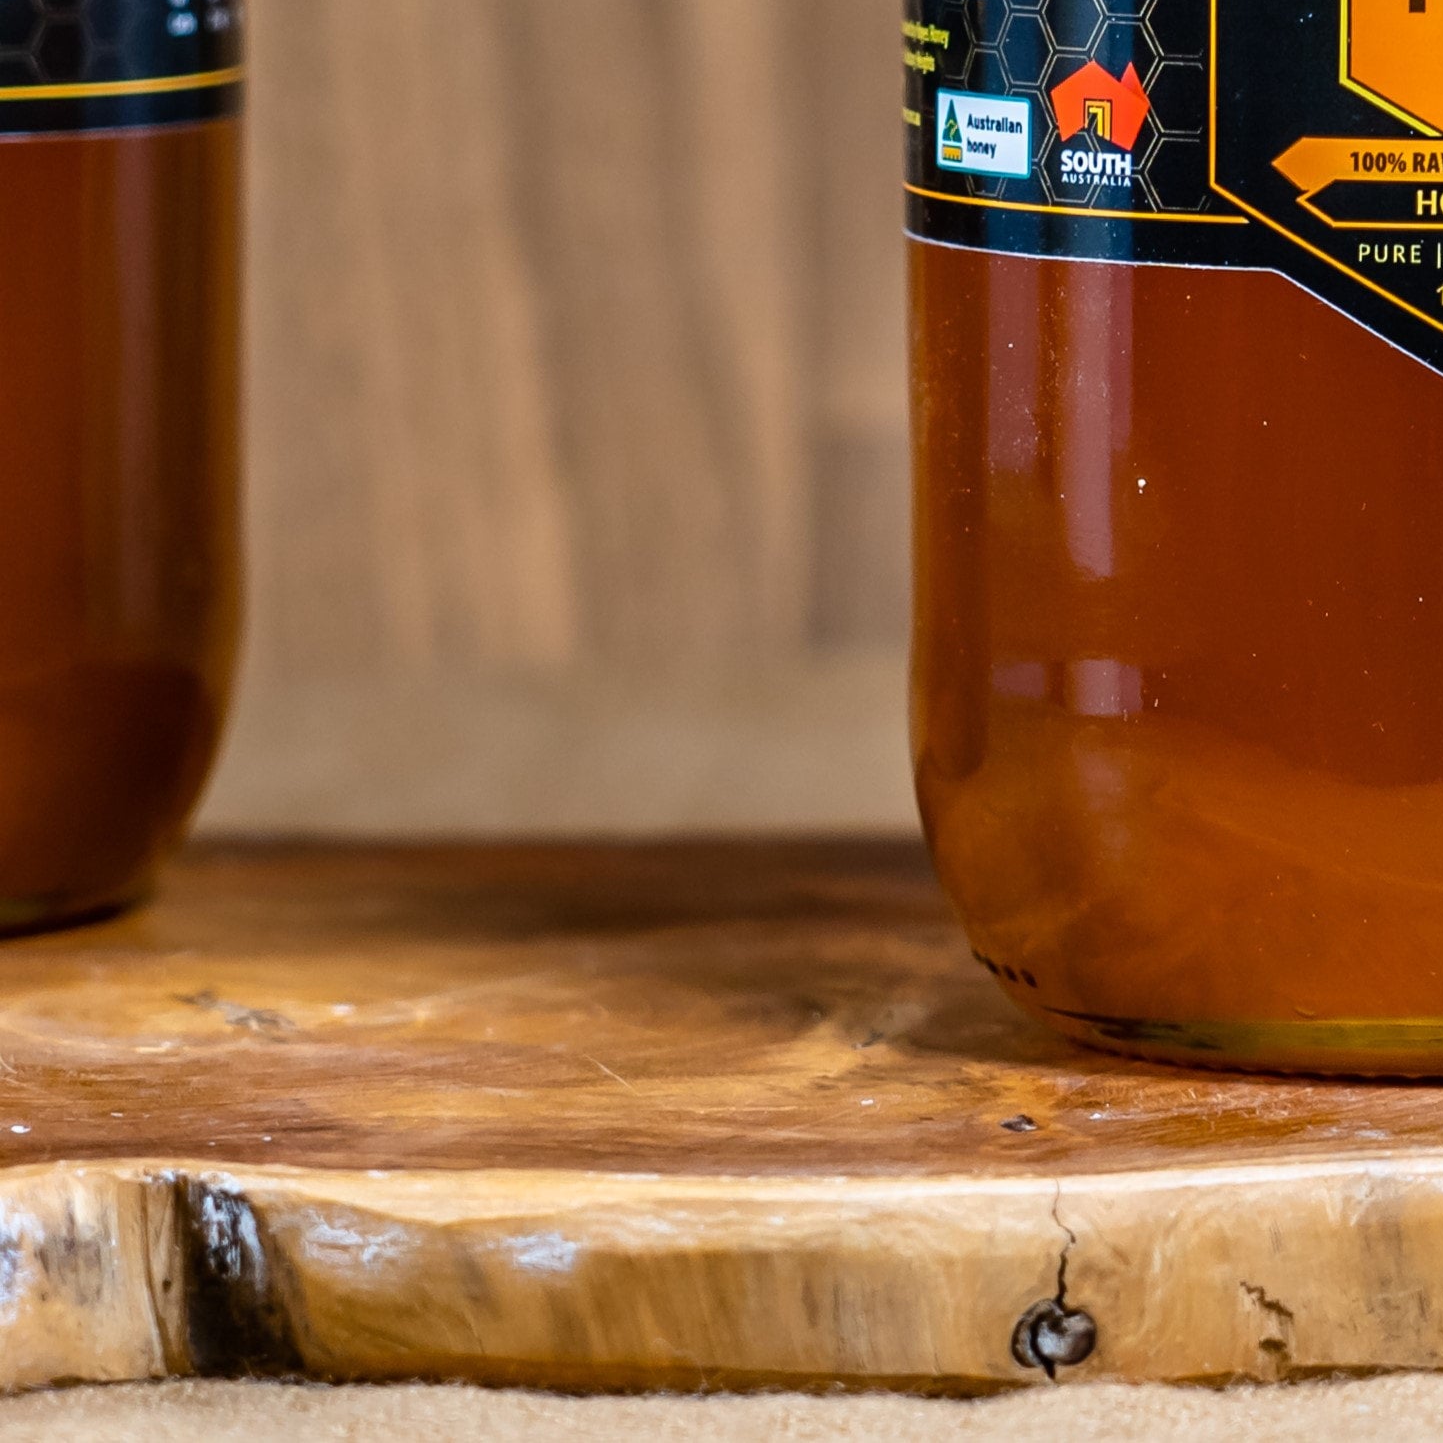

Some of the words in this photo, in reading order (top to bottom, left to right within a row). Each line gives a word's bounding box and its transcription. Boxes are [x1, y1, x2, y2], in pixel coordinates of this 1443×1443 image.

[966, 113, 1023, 134] Australian
[966, 138, 997, 159] honey
[1060, 150, 1132, 176] SOUTH
[1350, 151, 1407, 173] 100%
[1061, 173, 1132, 187] AUSTRALIA
[1358, 243, 1423, 264] PURE
